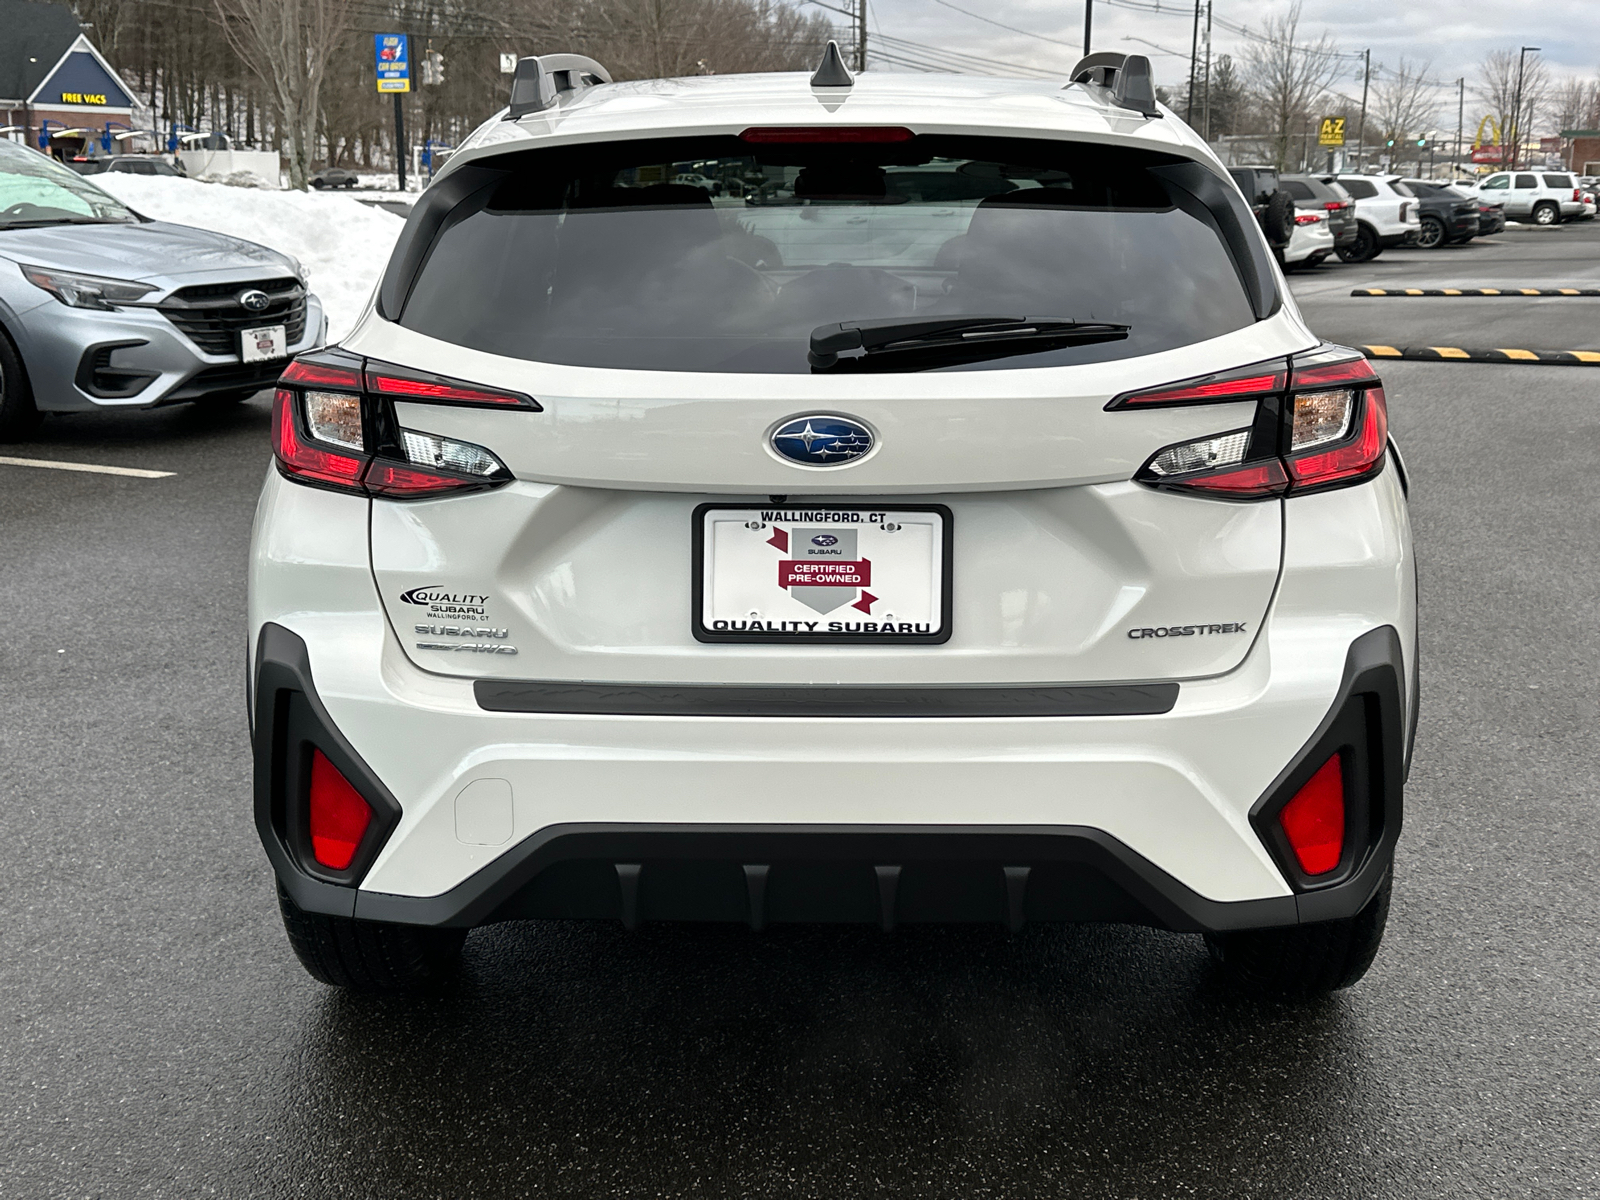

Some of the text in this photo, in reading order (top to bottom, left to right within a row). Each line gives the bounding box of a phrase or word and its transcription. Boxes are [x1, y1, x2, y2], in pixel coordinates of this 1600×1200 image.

[62, 92, 107, 105] FREE VACS
[869, 512, 886, 523] CT
[794, 564, 855, 574] CERTIFIED
[788, 574, 861, 583] PRE-OWNED
[416, 592, 490, 604] QUALITY
[430, 606, 485, 614] SUBARU
[426, 612, 478, 622] WALLINGFORD,
[414, 623, 509, 639] SUBARU
[712, 620, 931, 634] QUALITY SUBARU
[1127, 622, 1247, 640] CROSSTREK
[454, 643, 519, 656] AWD
